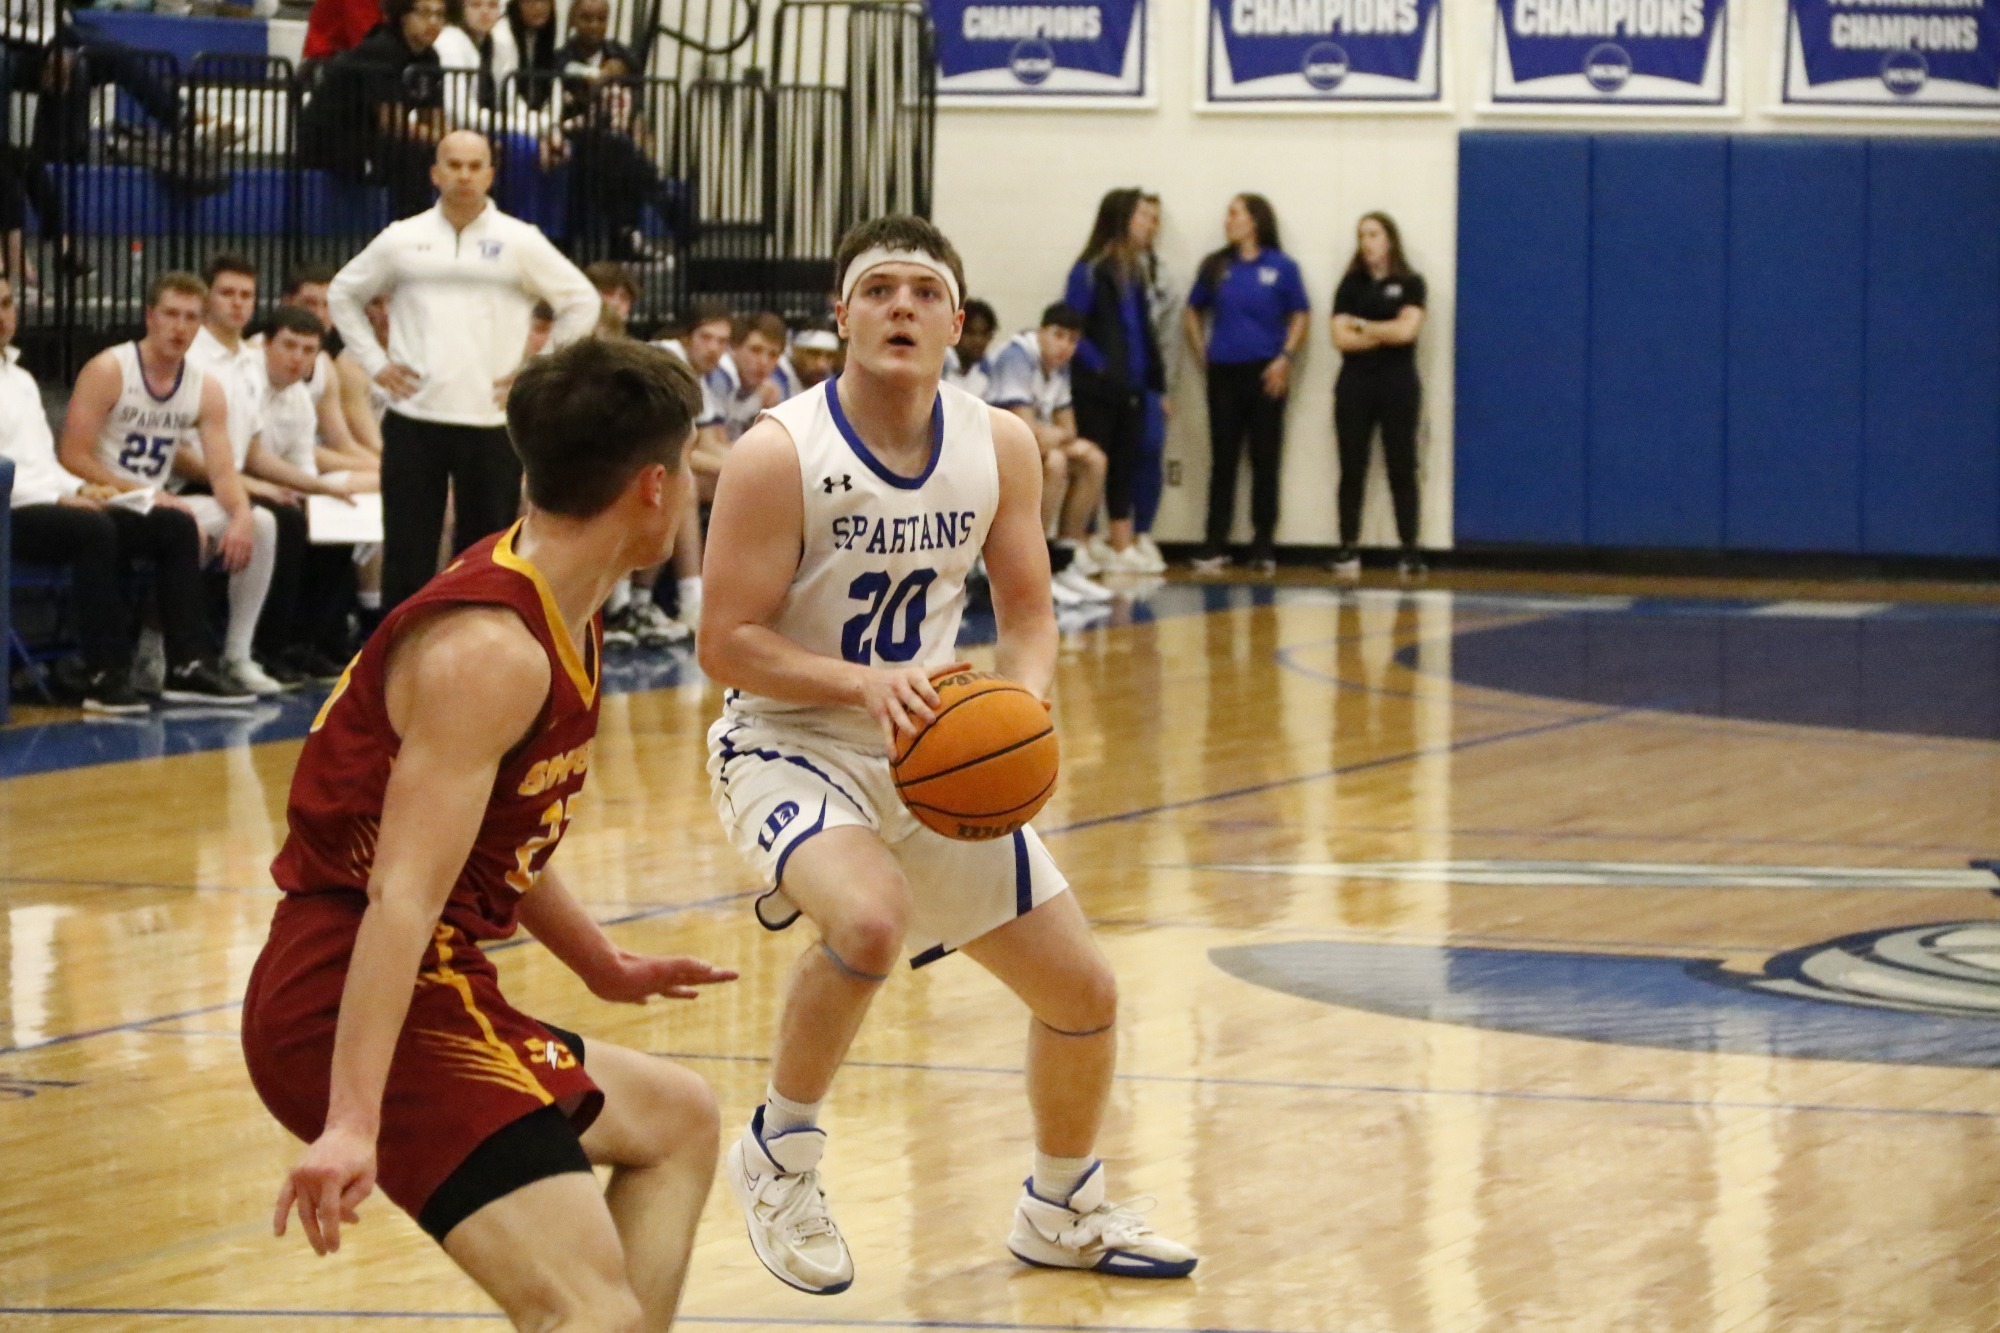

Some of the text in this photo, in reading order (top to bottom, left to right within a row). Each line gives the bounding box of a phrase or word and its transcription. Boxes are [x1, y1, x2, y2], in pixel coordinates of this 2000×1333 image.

[962, 5, 1102, 41] CHAMPIONS
[1231, 0, 1419, 35] CHAMPIONS
[1514, 0, 1705, 37] CHAMPIONS
[1831, 13, 1978, 50] CHAMPIONS
[118, 431, 175, 477] 25
[832, 511, 976, 554] SPARTANS
[841, 567, 938, 667] 20
